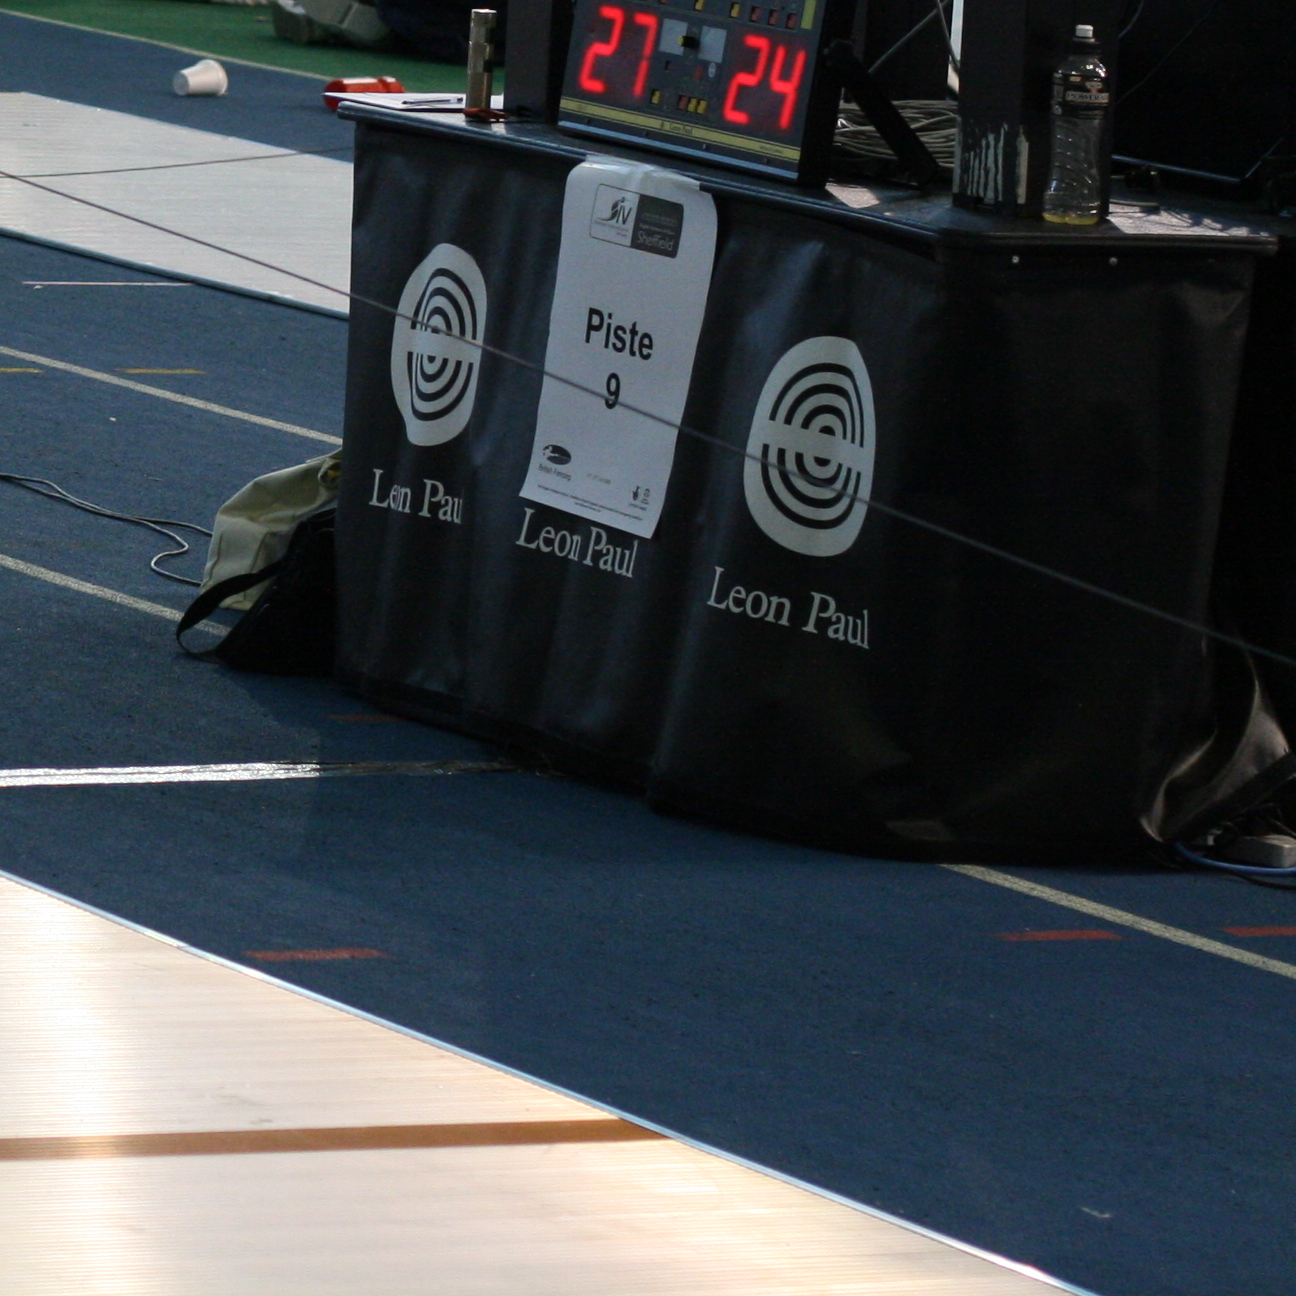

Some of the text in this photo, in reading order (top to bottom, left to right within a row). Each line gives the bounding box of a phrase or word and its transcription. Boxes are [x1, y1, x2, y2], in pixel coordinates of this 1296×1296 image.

[578, 6, 806, 129] 27 24
[585, 307, 653, 360] Piste
[605, 372, 621, 409] 9
[418, 478, 464, 524] Pau
[515, 507, 639, 578] Leon Paul
[706, 566, 870, 650] Leon Paul
